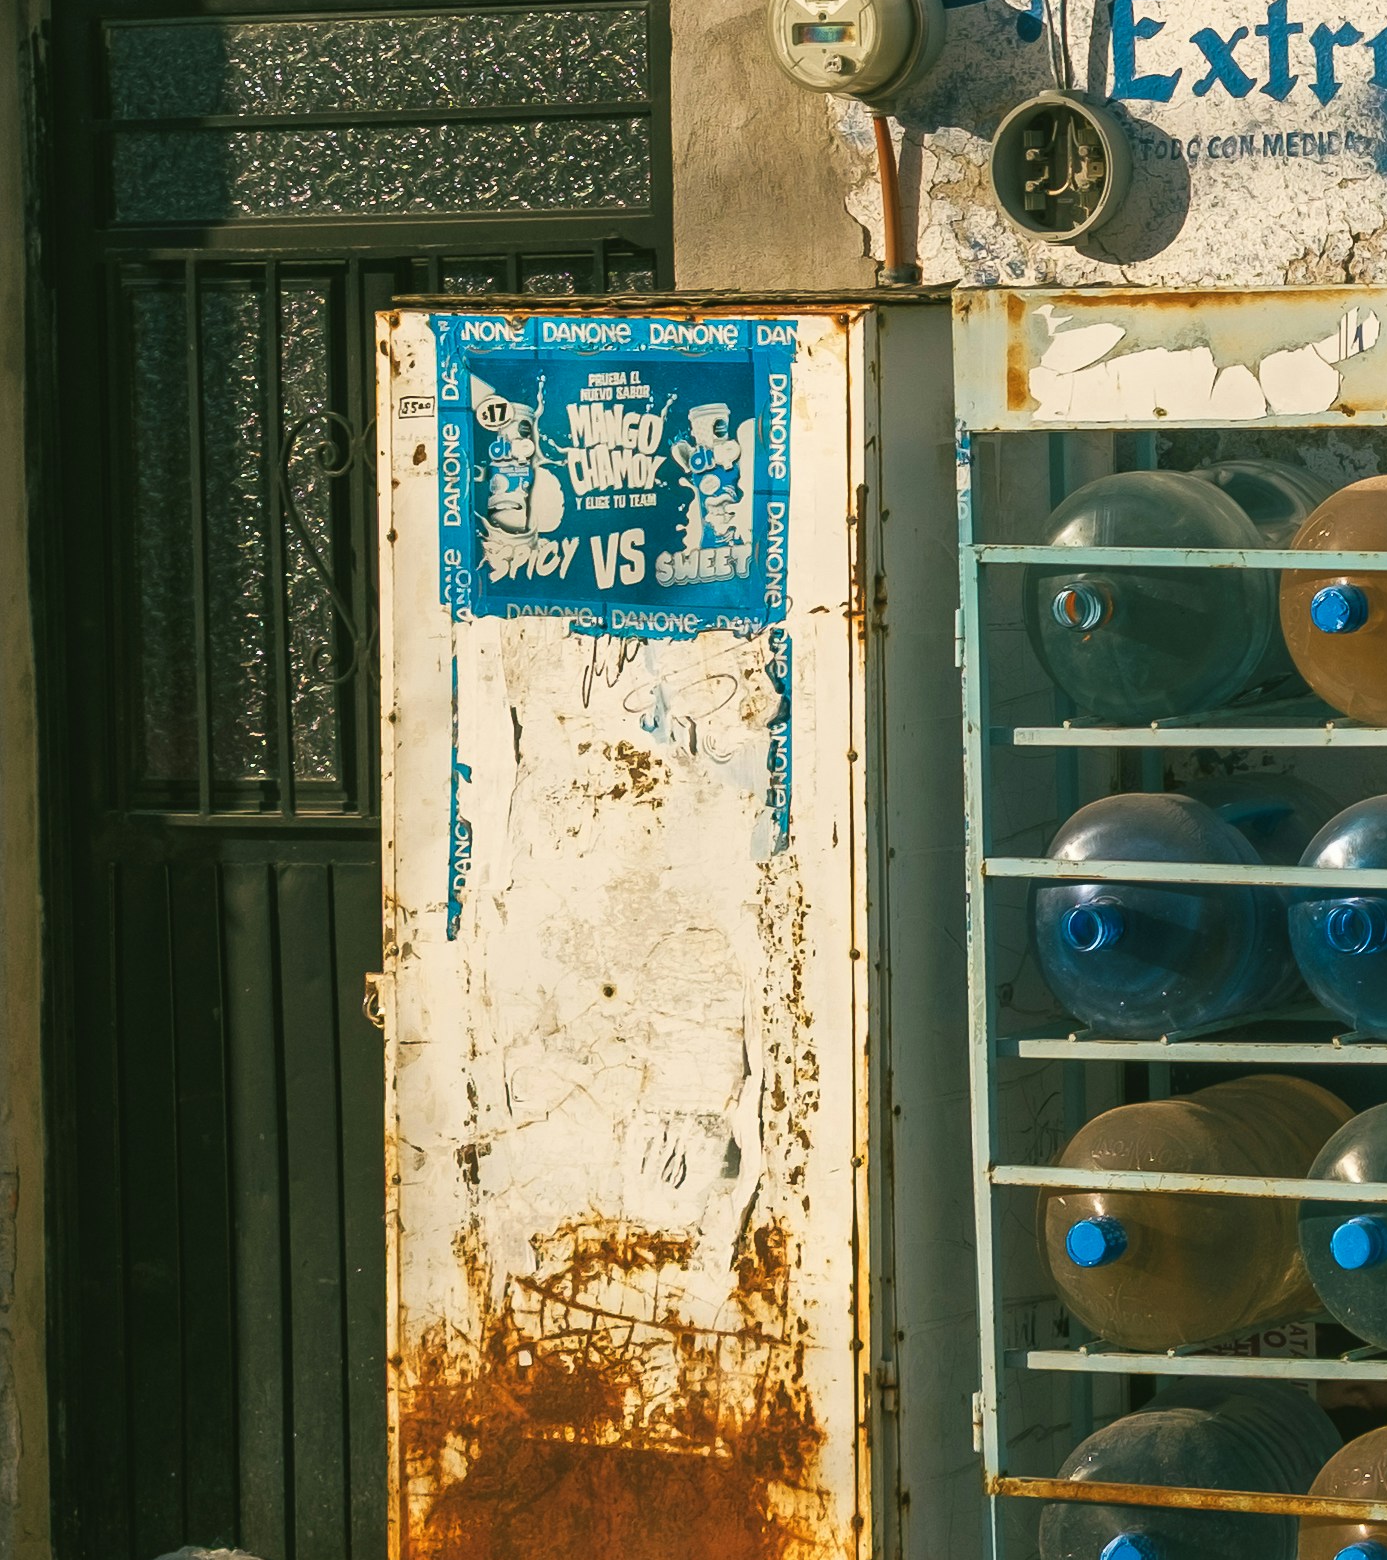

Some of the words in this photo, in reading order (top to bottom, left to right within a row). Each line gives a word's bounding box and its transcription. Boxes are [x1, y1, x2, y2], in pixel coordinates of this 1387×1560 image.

[1206, 134, 1255, 159] CON
[481, 402, 508, 424] $17
[566, 402, 664, 455] MANGO
[568, 442, 667, 497] CHAMOY
[614, 494, 626, 509] TU
[629, 493, 657, 507] TEAM
[482, 537, 580, 584] SPICY
[590, 528, 645, 591] VS
[655, 543, 752, 588] SWEET
